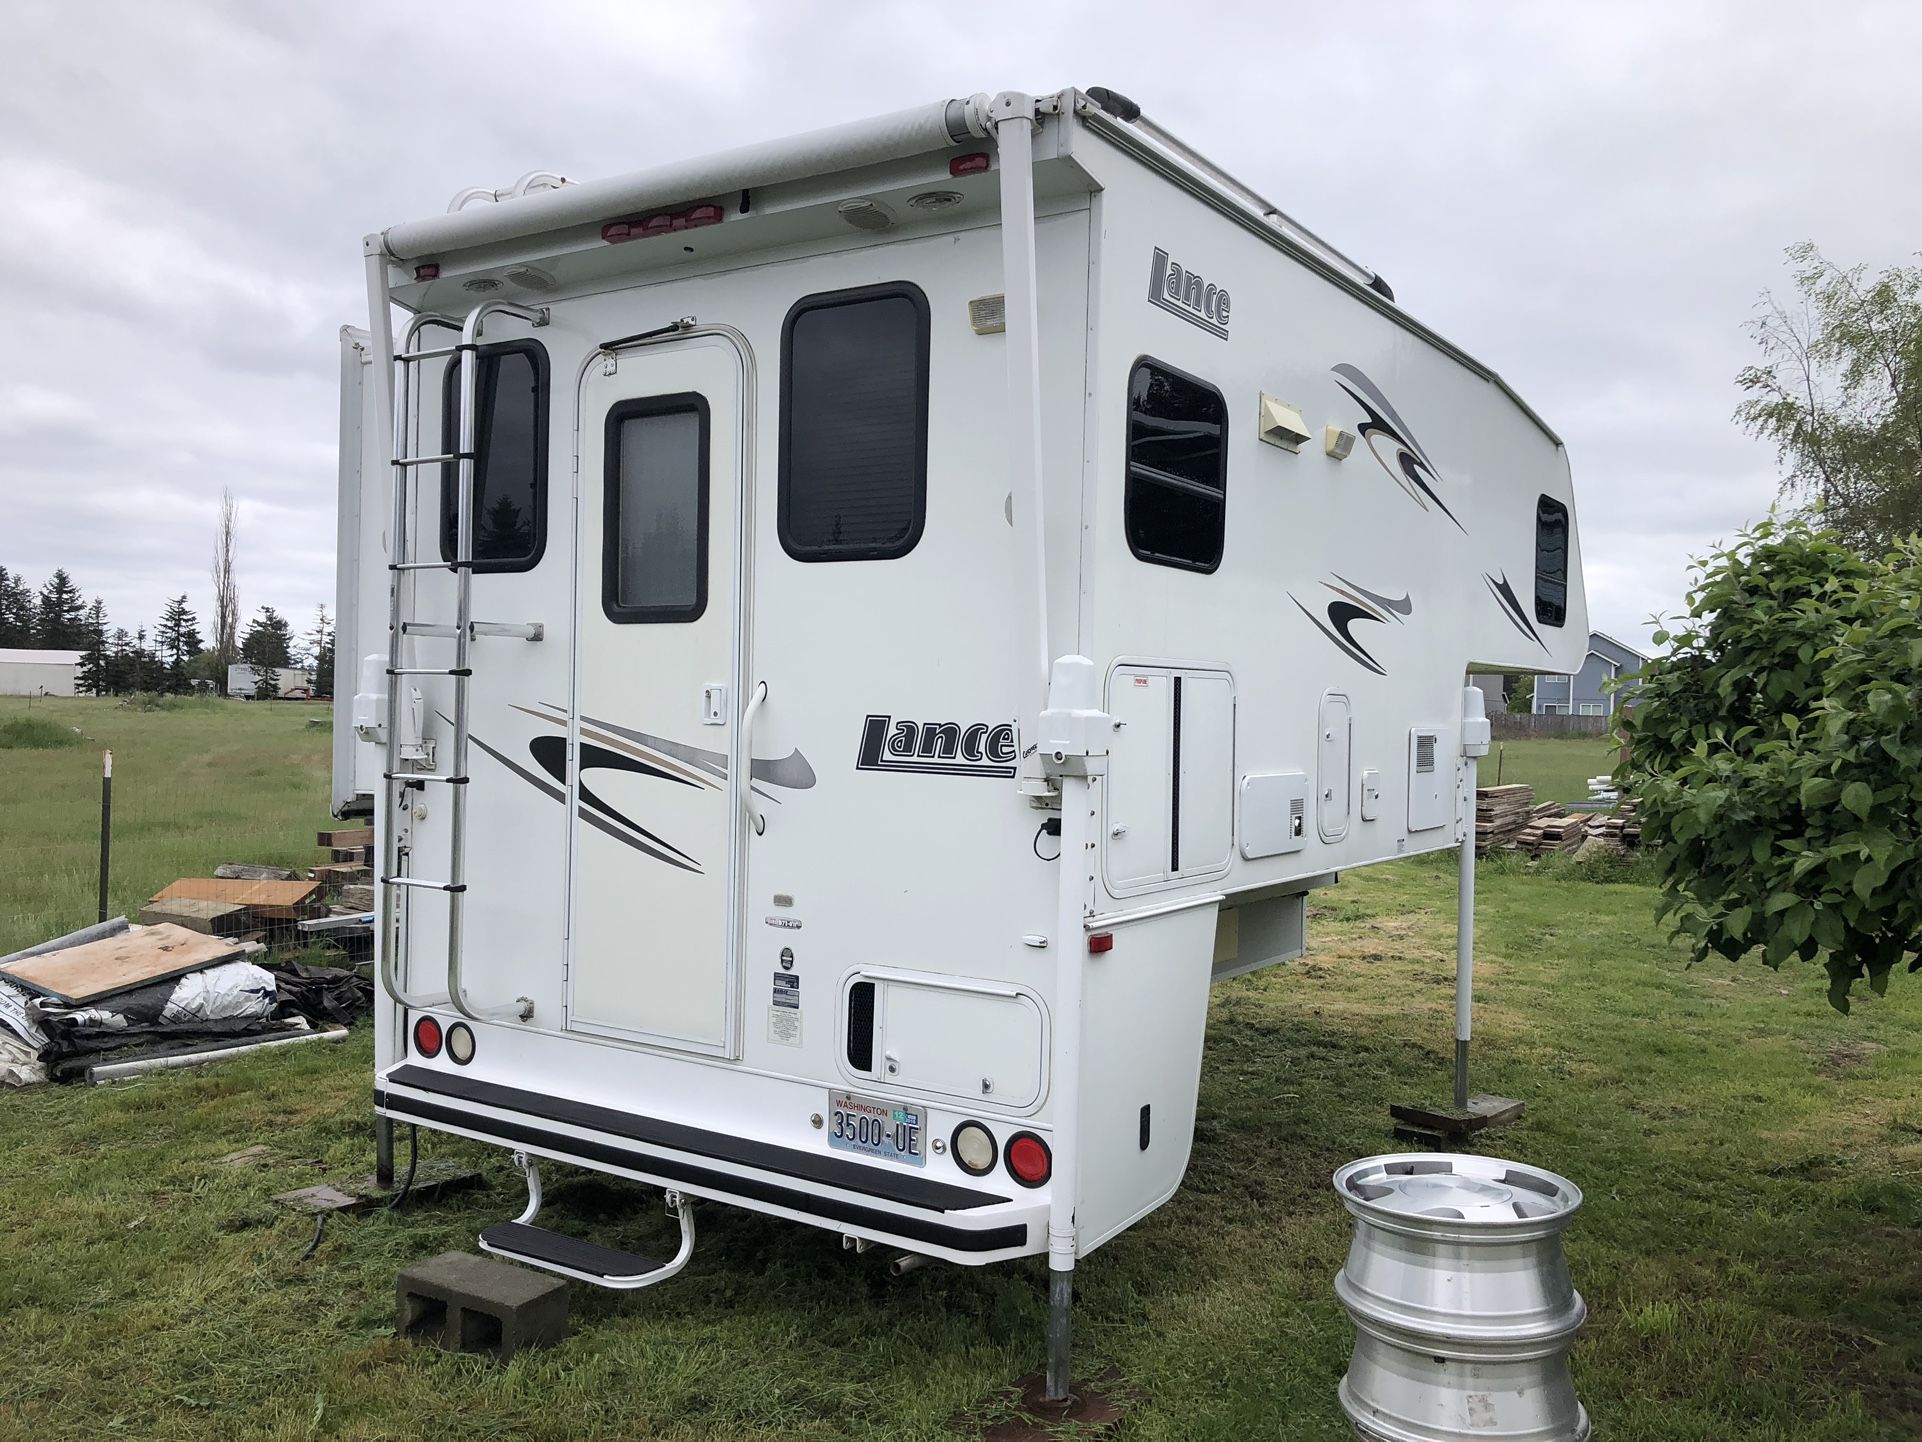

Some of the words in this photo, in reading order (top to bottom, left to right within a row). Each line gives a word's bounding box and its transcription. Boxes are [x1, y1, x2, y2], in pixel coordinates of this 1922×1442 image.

[1148, 246, 1230, 341] Lance
[856, 715, 1017, 779] Lance
[835, 1099, 888, 1117] WASHINGTON
[833, 1110, 920, 1156] 3500-UE
[853, 1144, 882, 1155] EVERGREEN
